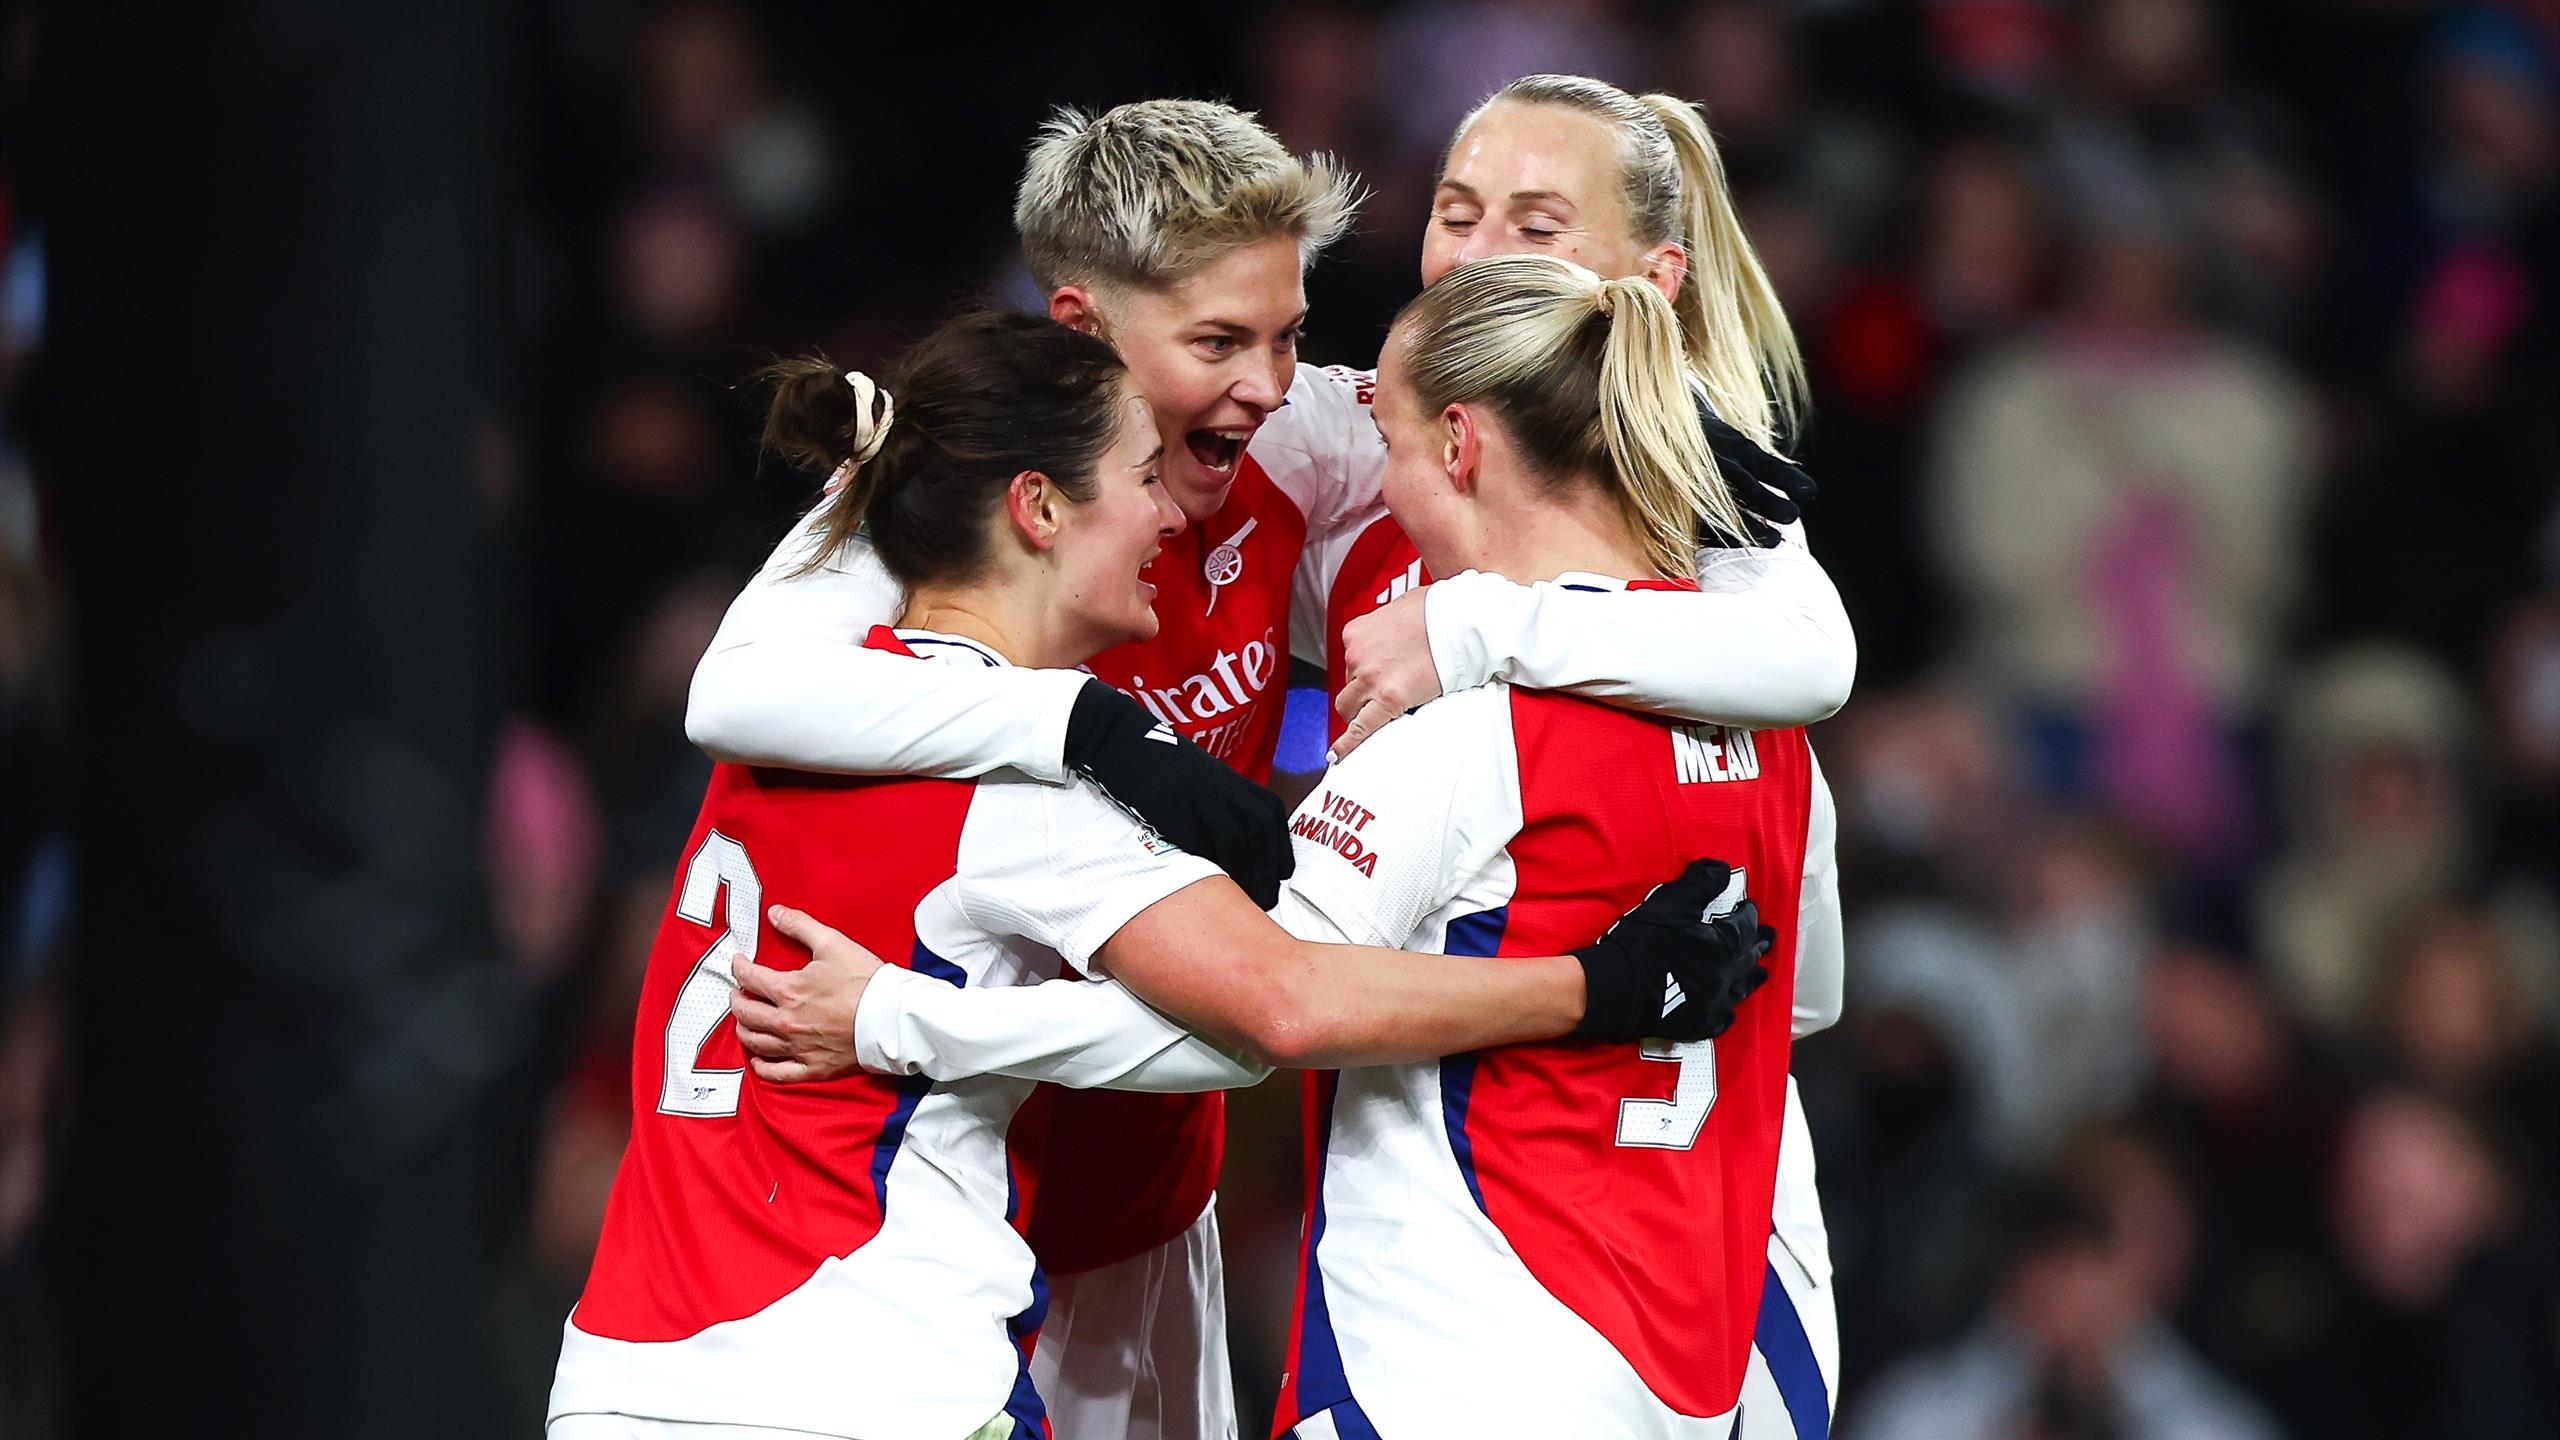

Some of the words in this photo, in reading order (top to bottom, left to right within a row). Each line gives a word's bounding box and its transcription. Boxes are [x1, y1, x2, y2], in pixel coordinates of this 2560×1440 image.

[1114, 626, 1276, 726] irates
[1671, 725, 1760, 785] MEAD
[1321, 790, 1376, 832] VISIT
[1289, 813, 1378, 879] RWANDA
[657, 827, 762, 1118] 2
